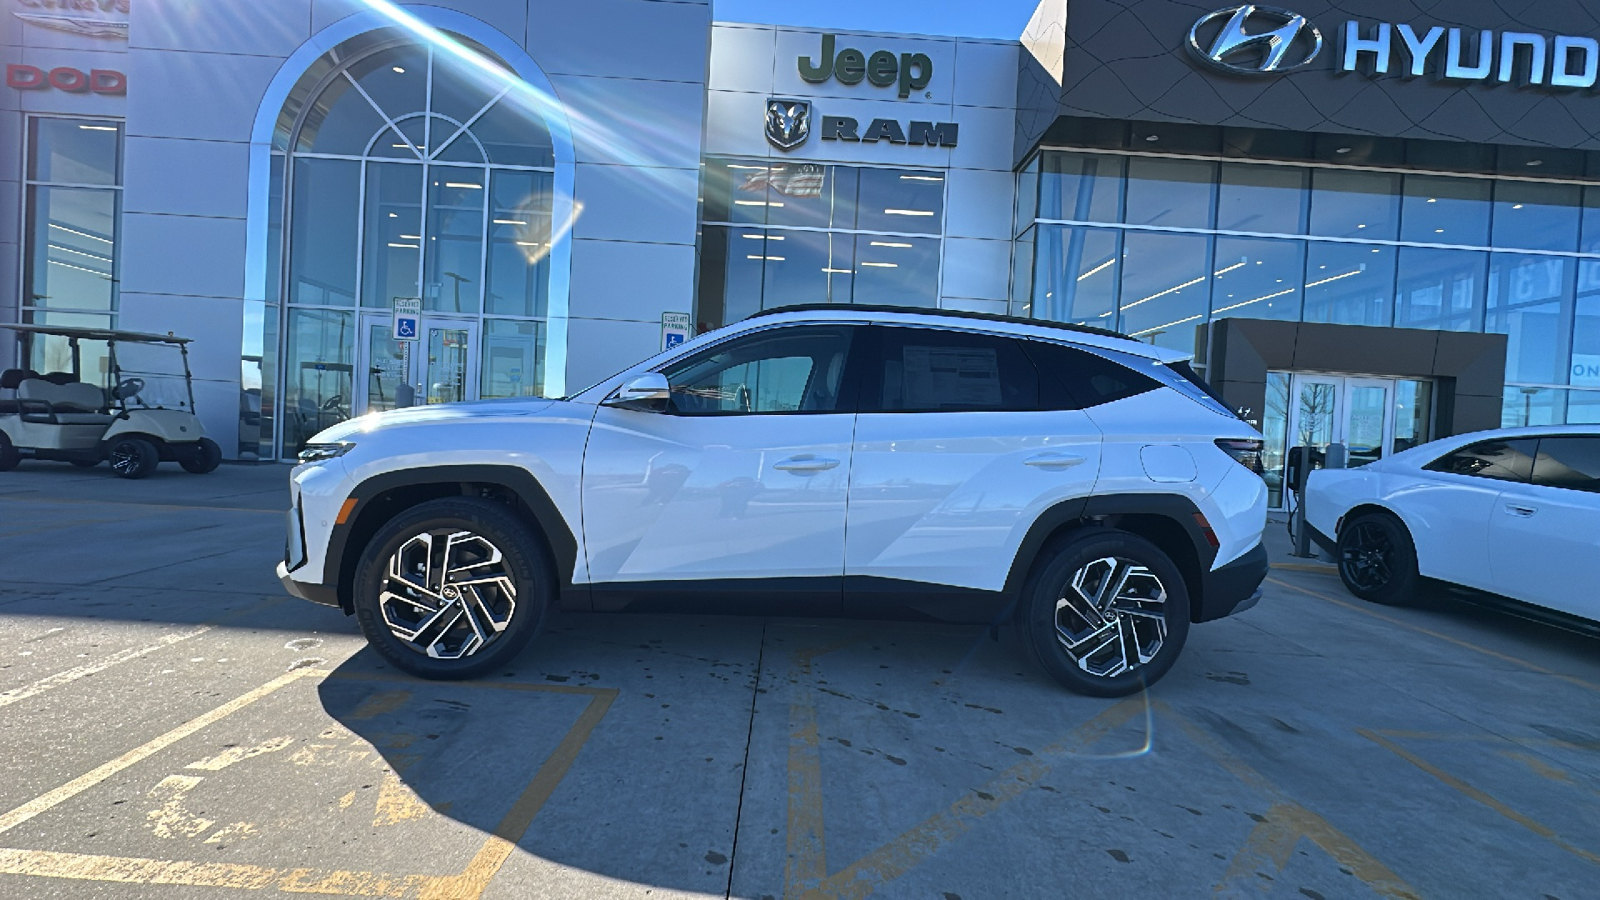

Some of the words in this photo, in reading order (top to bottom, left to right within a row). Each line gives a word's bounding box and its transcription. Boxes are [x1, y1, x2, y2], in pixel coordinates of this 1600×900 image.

[797, 33, 933, 98] Jeep
[1341, 20, 1599, 88] HYUND
[6, 63, 127, 94] DOD
[821, 115, 959, 147] RAM
[395, 307, 419, 316] PARKING
[664, 322, 688, 331] PARKING
